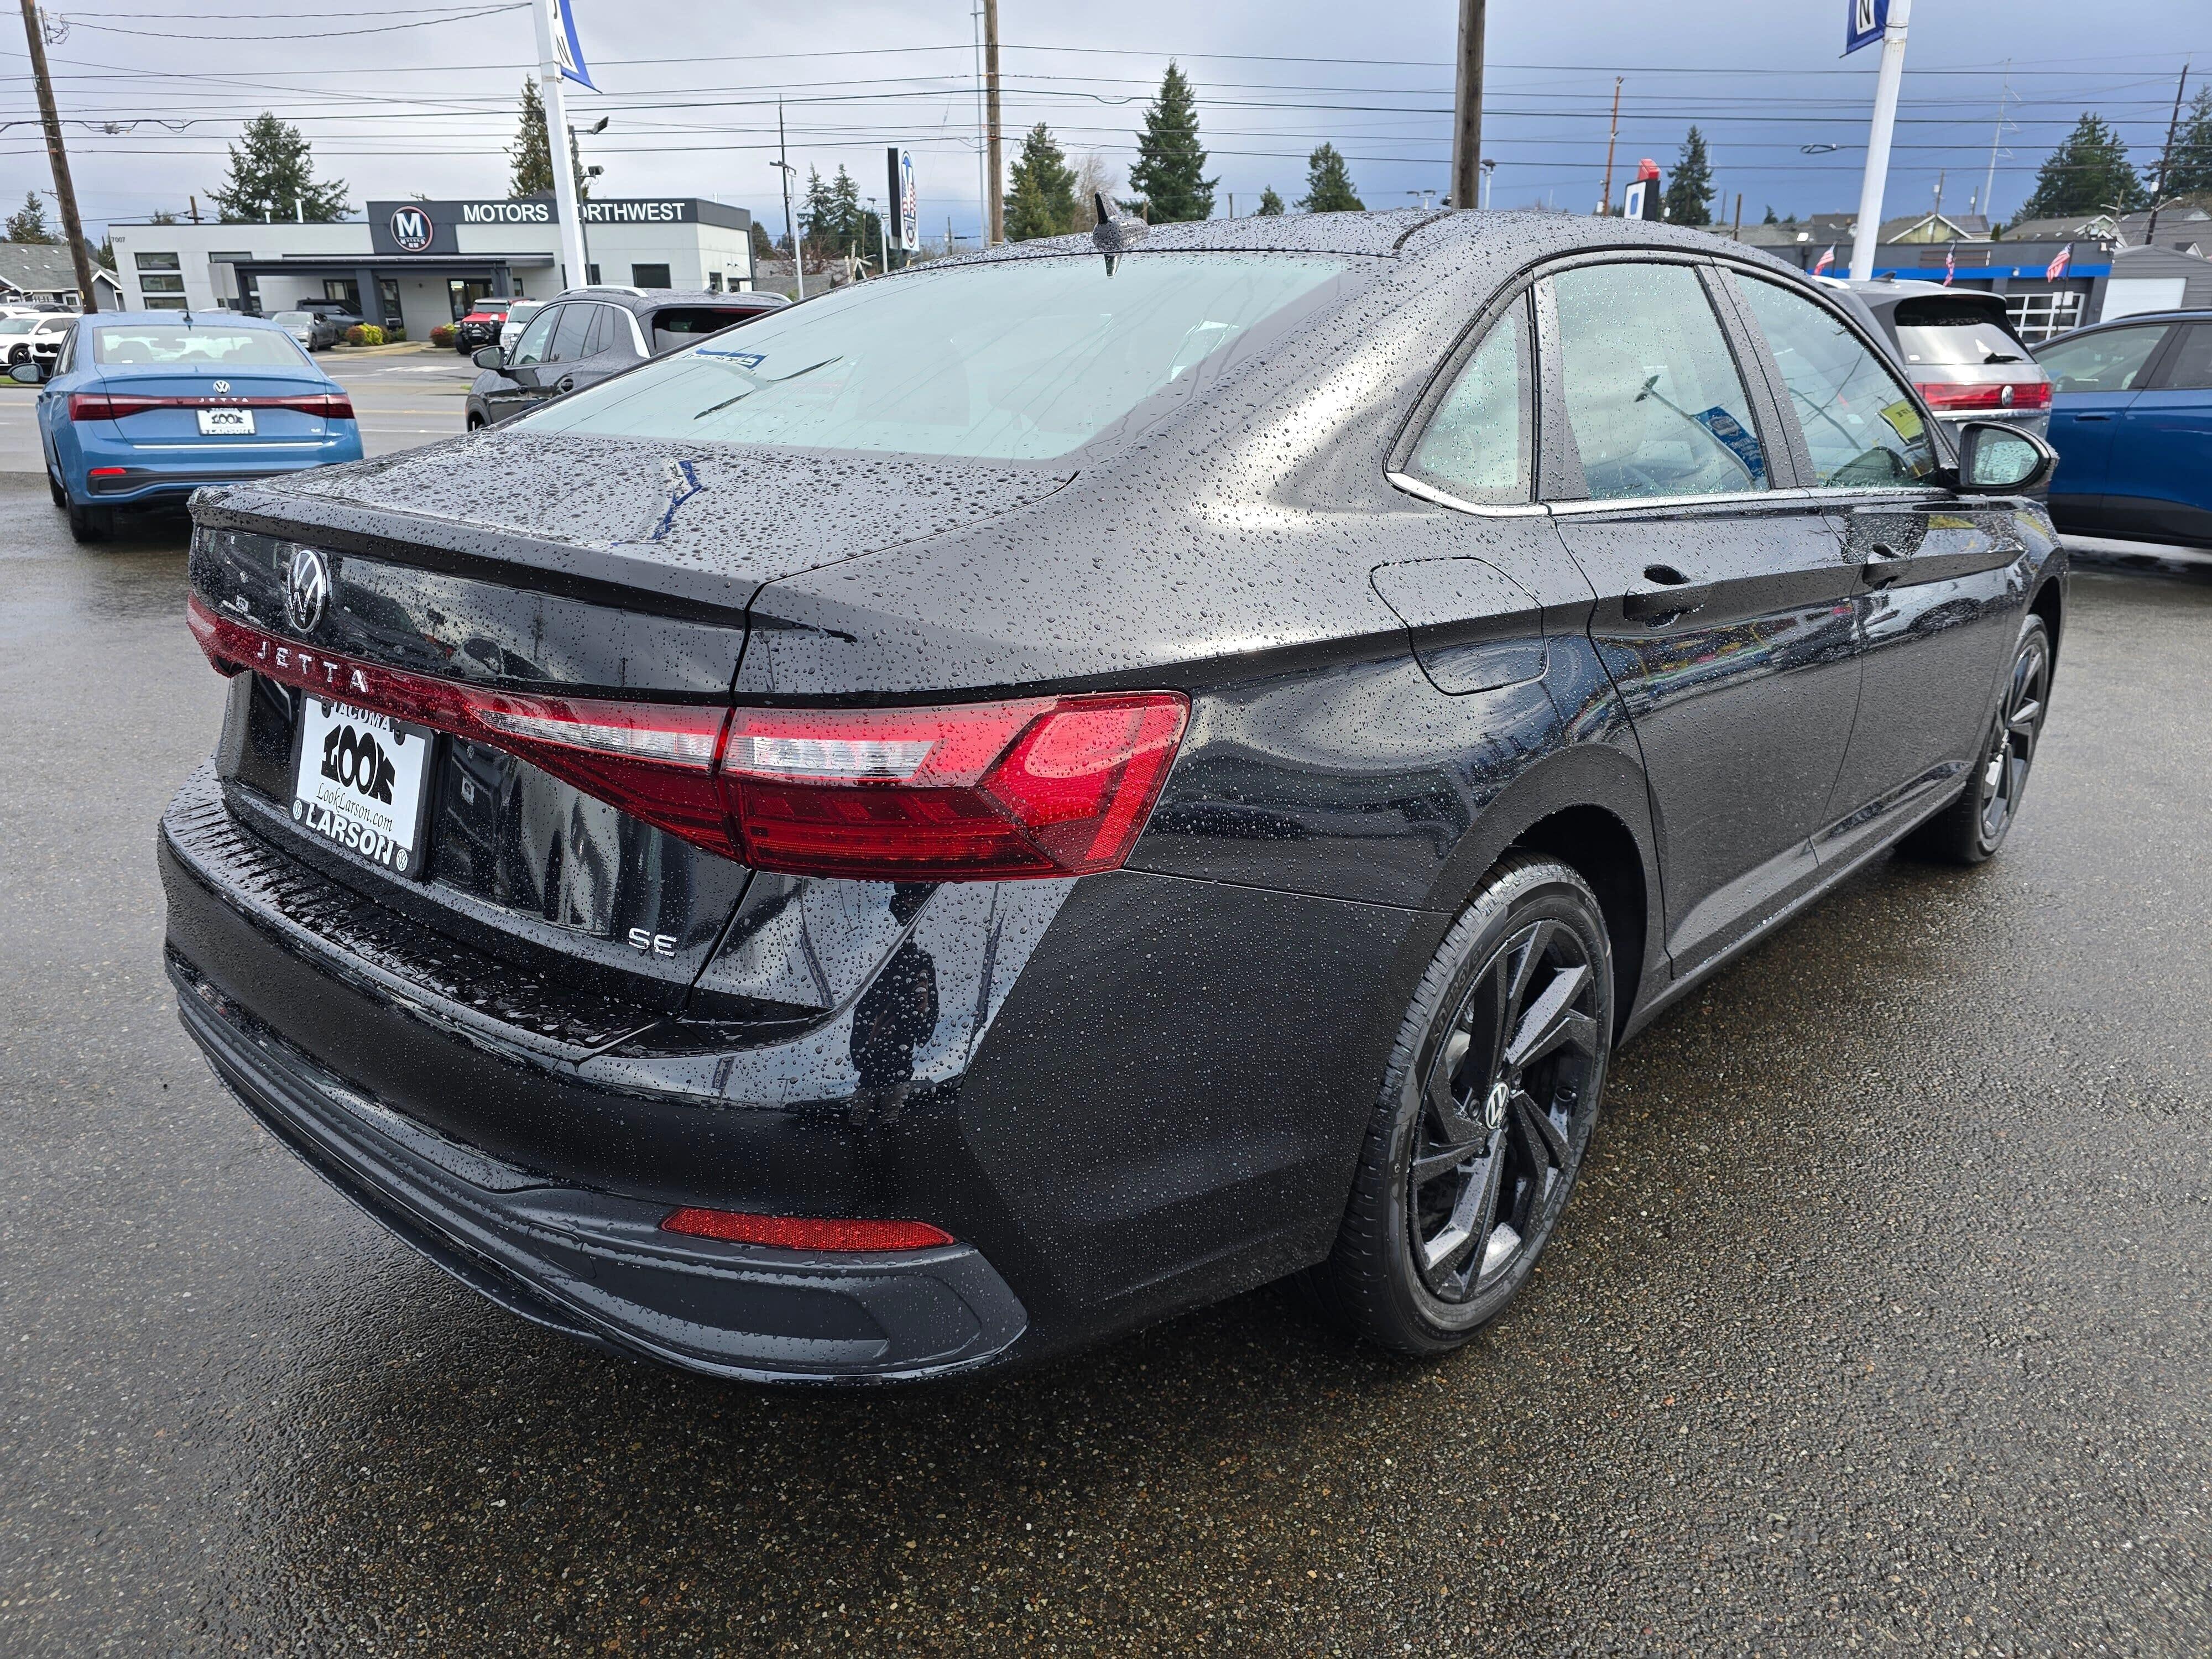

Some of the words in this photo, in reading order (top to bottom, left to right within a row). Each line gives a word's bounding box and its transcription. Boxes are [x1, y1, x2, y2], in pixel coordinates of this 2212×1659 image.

[396, 213, 425, 237] M
[463, 204, 549, 222] MOTORS
[576, 202, 685, 221] RTHWEST
[257, 641, 369, 693] JETTA
[321, 724, 395, 805] LOOK
[316, 782, 394, 832] LookLarson.com
[306, 803, 394, 865] LARSON
[628, 927, 677, 957] SE
[1472, 943, 1483, 964] GT
